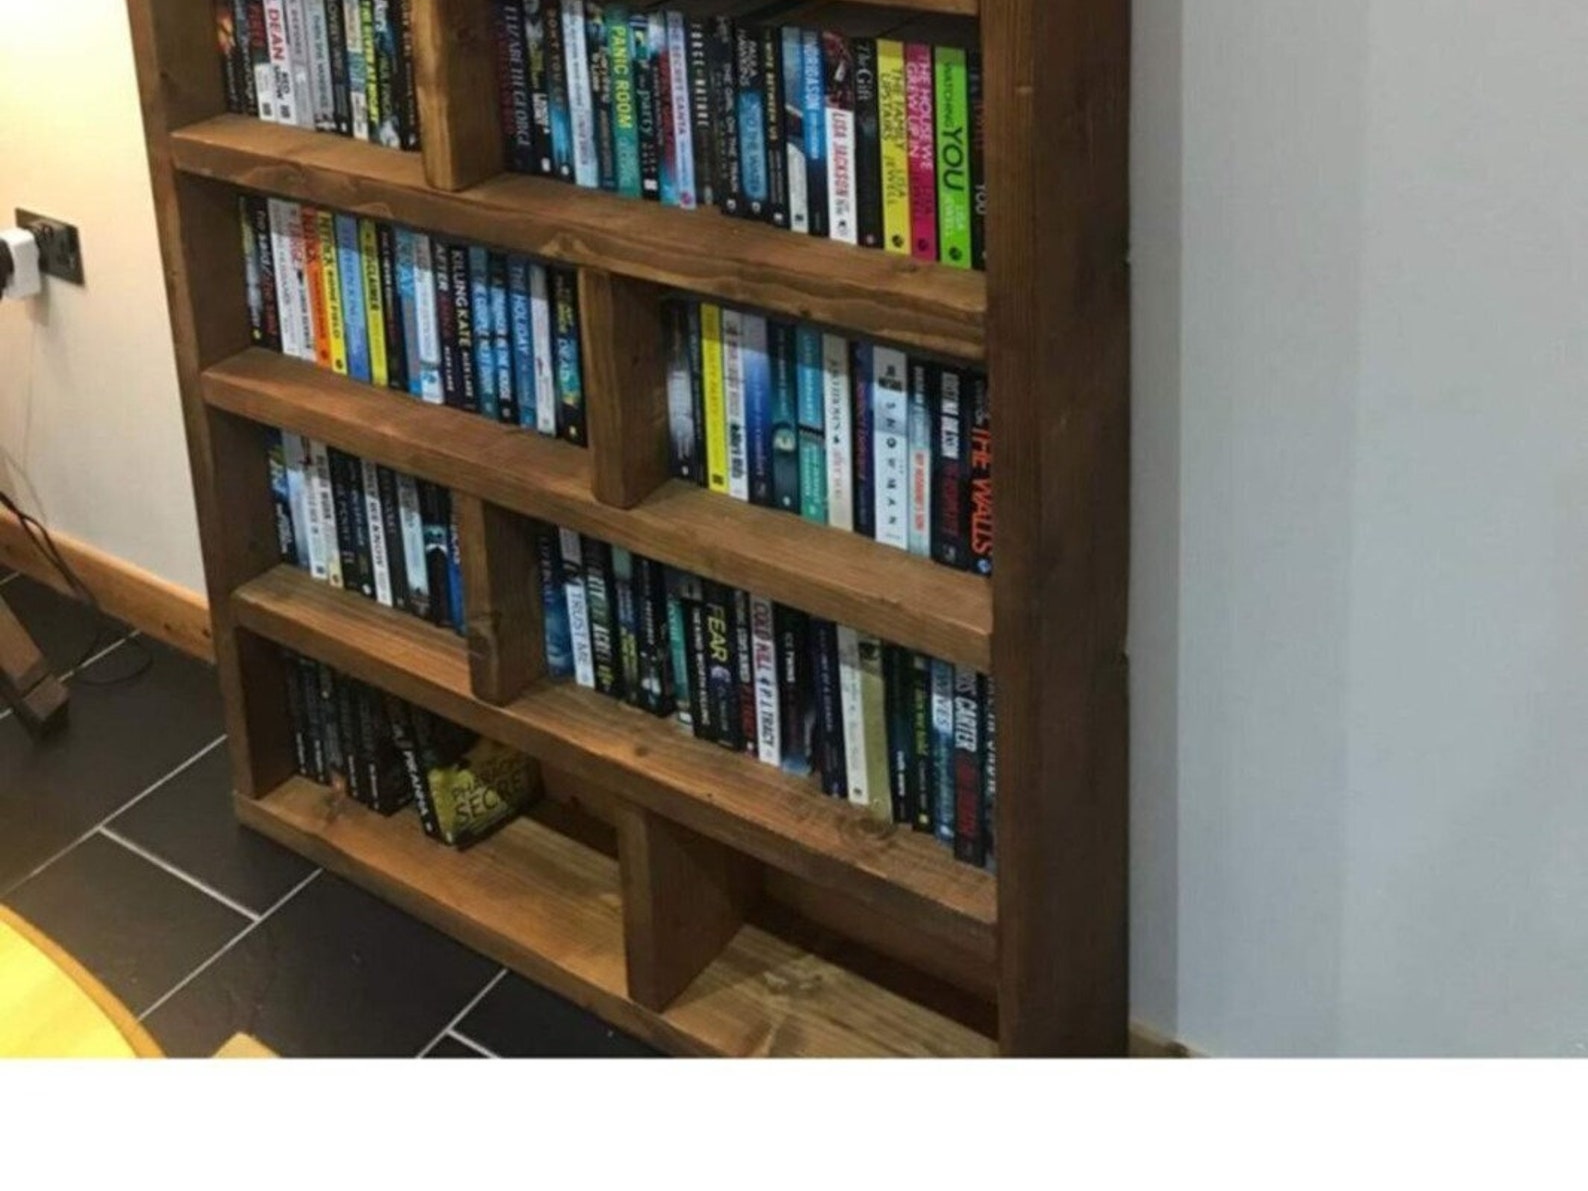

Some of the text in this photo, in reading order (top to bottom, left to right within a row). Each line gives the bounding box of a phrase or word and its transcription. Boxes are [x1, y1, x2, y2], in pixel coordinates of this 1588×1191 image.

[267, 8, 284, 61] DEAN
[611, 26, 628, 75] PANIC
[856, 45, 873, 101] The Gift
[616, 80, 631, 128] ROOM
[637, 89, 654, 136] party
[674, 95, 686, 136] SANTA
[881, 72, 893, 142] UPSTAIRS
[892, 69, 905, 152] THE FAMILY
[906, 61, 919, 159] GREW UP IN
[919, 56, 932, 172] THE HOUSE WE
[942, 62, 963, 191] WATCHING YOU
[832, 113, 848, 196] LISA JACKSON
[885, 156, 895, 207] JEWELL
[897, 169, 906, 198] LISA
[975, 184, 987, 215] YOU
[364, 244, 379, 311] DISCLAIMER
[435, 244, 448, 291] AFTER
[452, 250, 471, 347] KILLING KATE
[513, 294, 528, 354] HOLIDAY
[971, 426, 993, 555] THE WALLS
[570, 591, 586, 637] TRUST
[707, 603, 728, 662] FEAR
[753, 602, 770, 638] COLD
[761, 710, 775, 747] TRACY
[954, 696, 977, 752] CARTER
